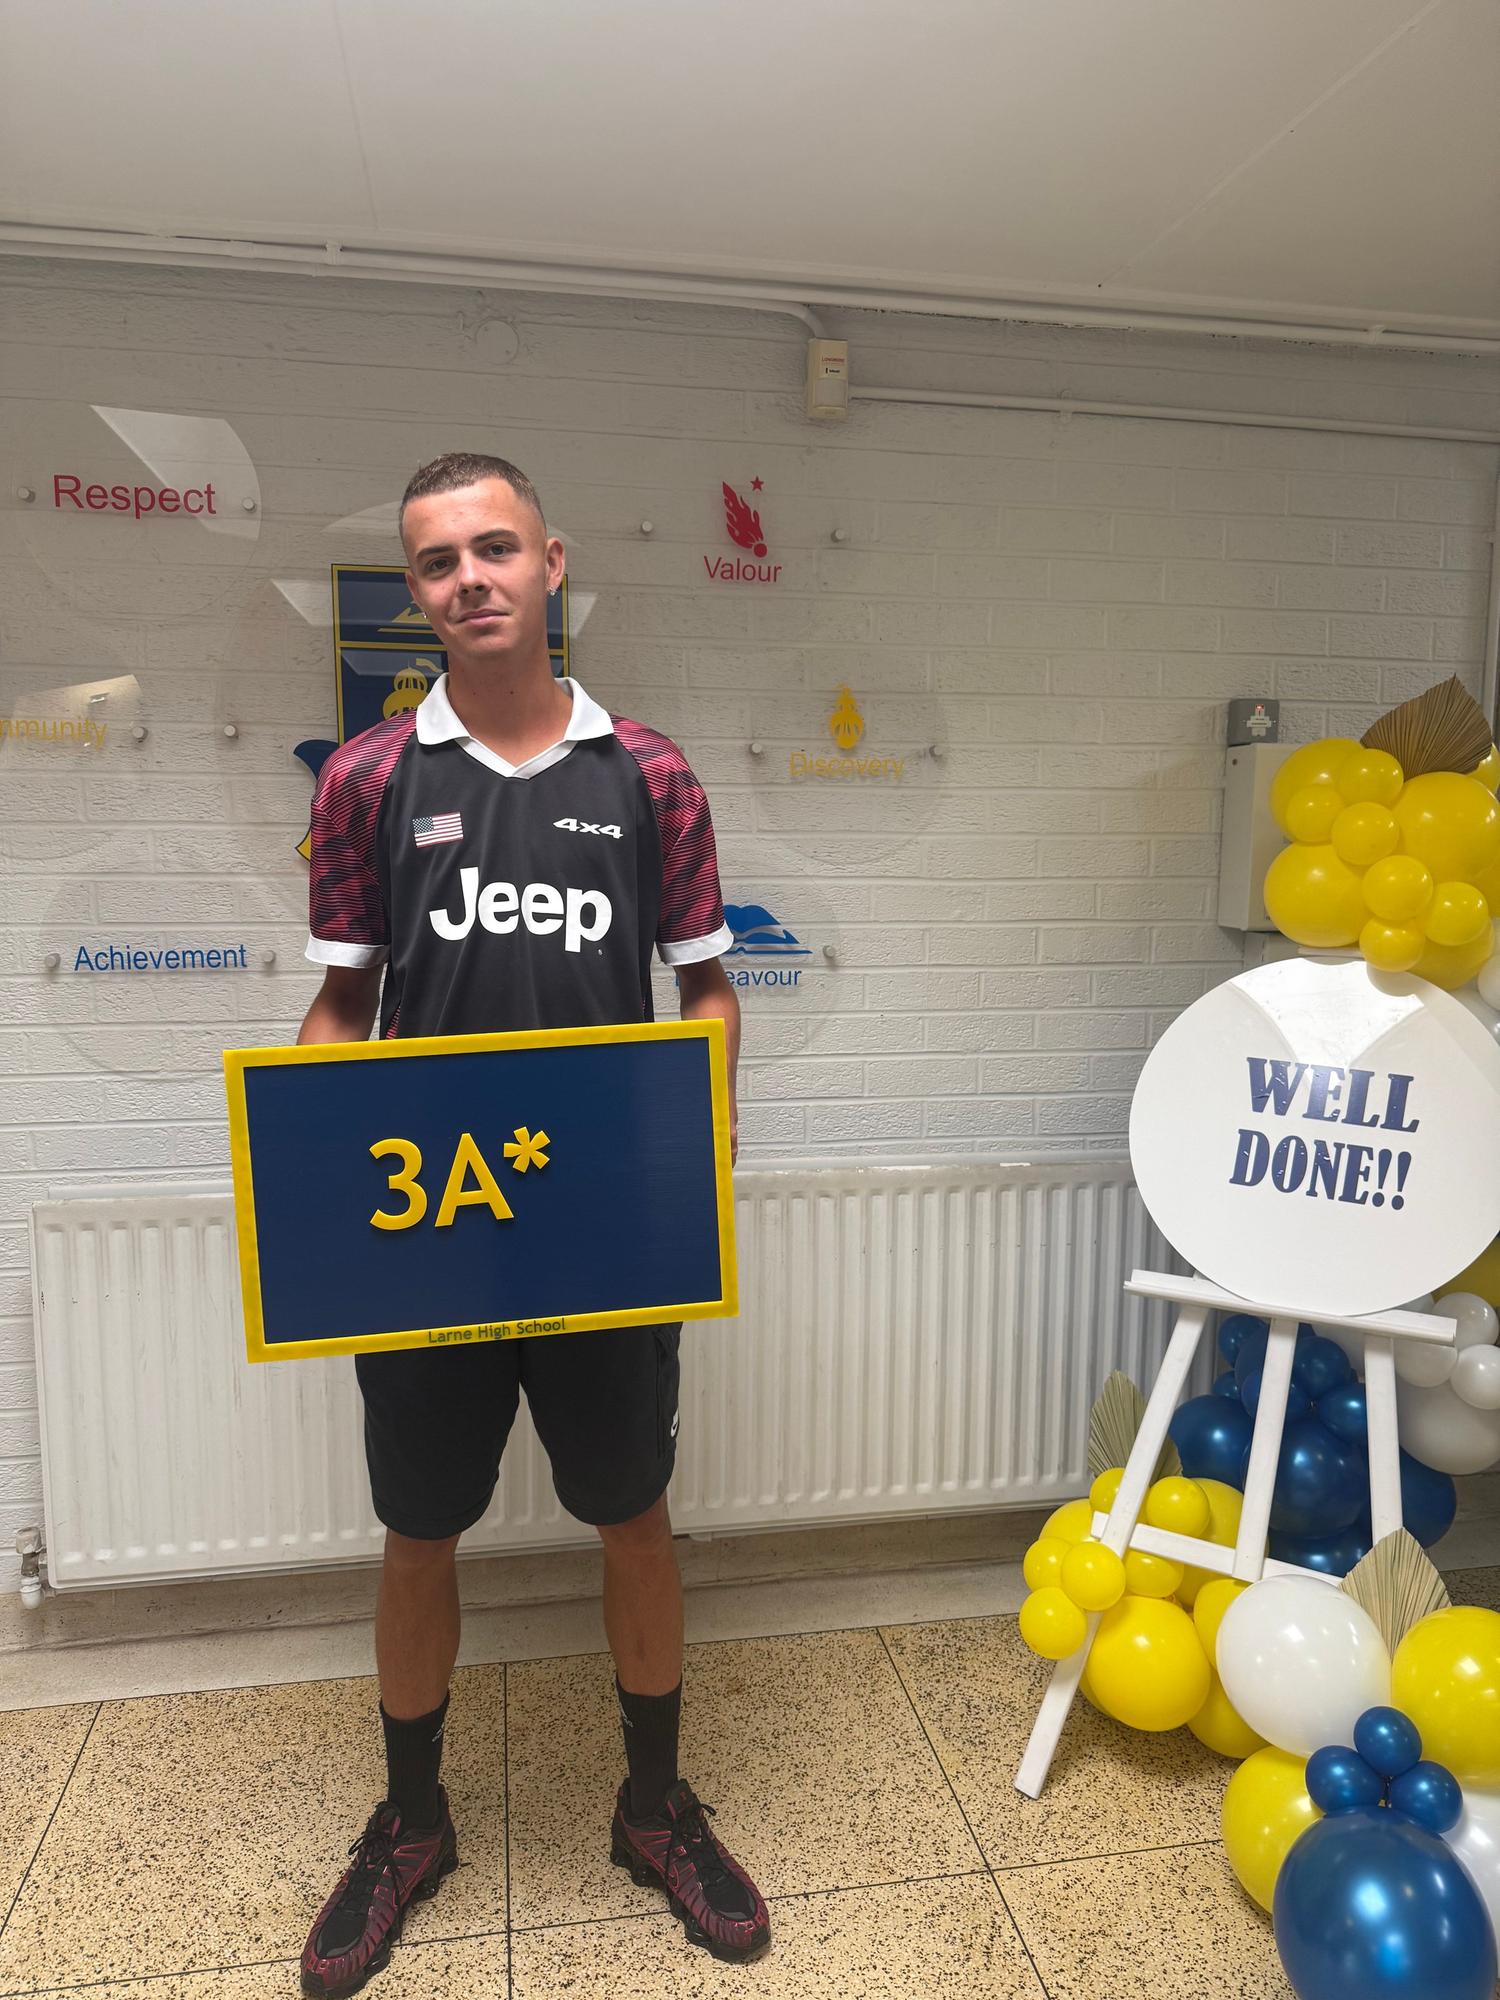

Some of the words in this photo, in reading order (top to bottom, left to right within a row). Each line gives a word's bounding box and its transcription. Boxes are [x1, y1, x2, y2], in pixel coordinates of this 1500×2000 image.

[53, 474, 217, 519] Respect
[703, 555, 783, 583] Valour
[789, 751, 905, 779] Discovery
[552, 817, 624, 839] 4x4
[429, 866, 613, 953] Jeep
[74, 944, 248, 971] Achievement
[1246, 1056, 1420, 1133] WELL
[1228, 1128, 1412, 1211] DONE!!
[428, 1330, 473, 1344] Larne
[477, 1323, 511, 1340] High
[516, 1317, 566, 1335] School
